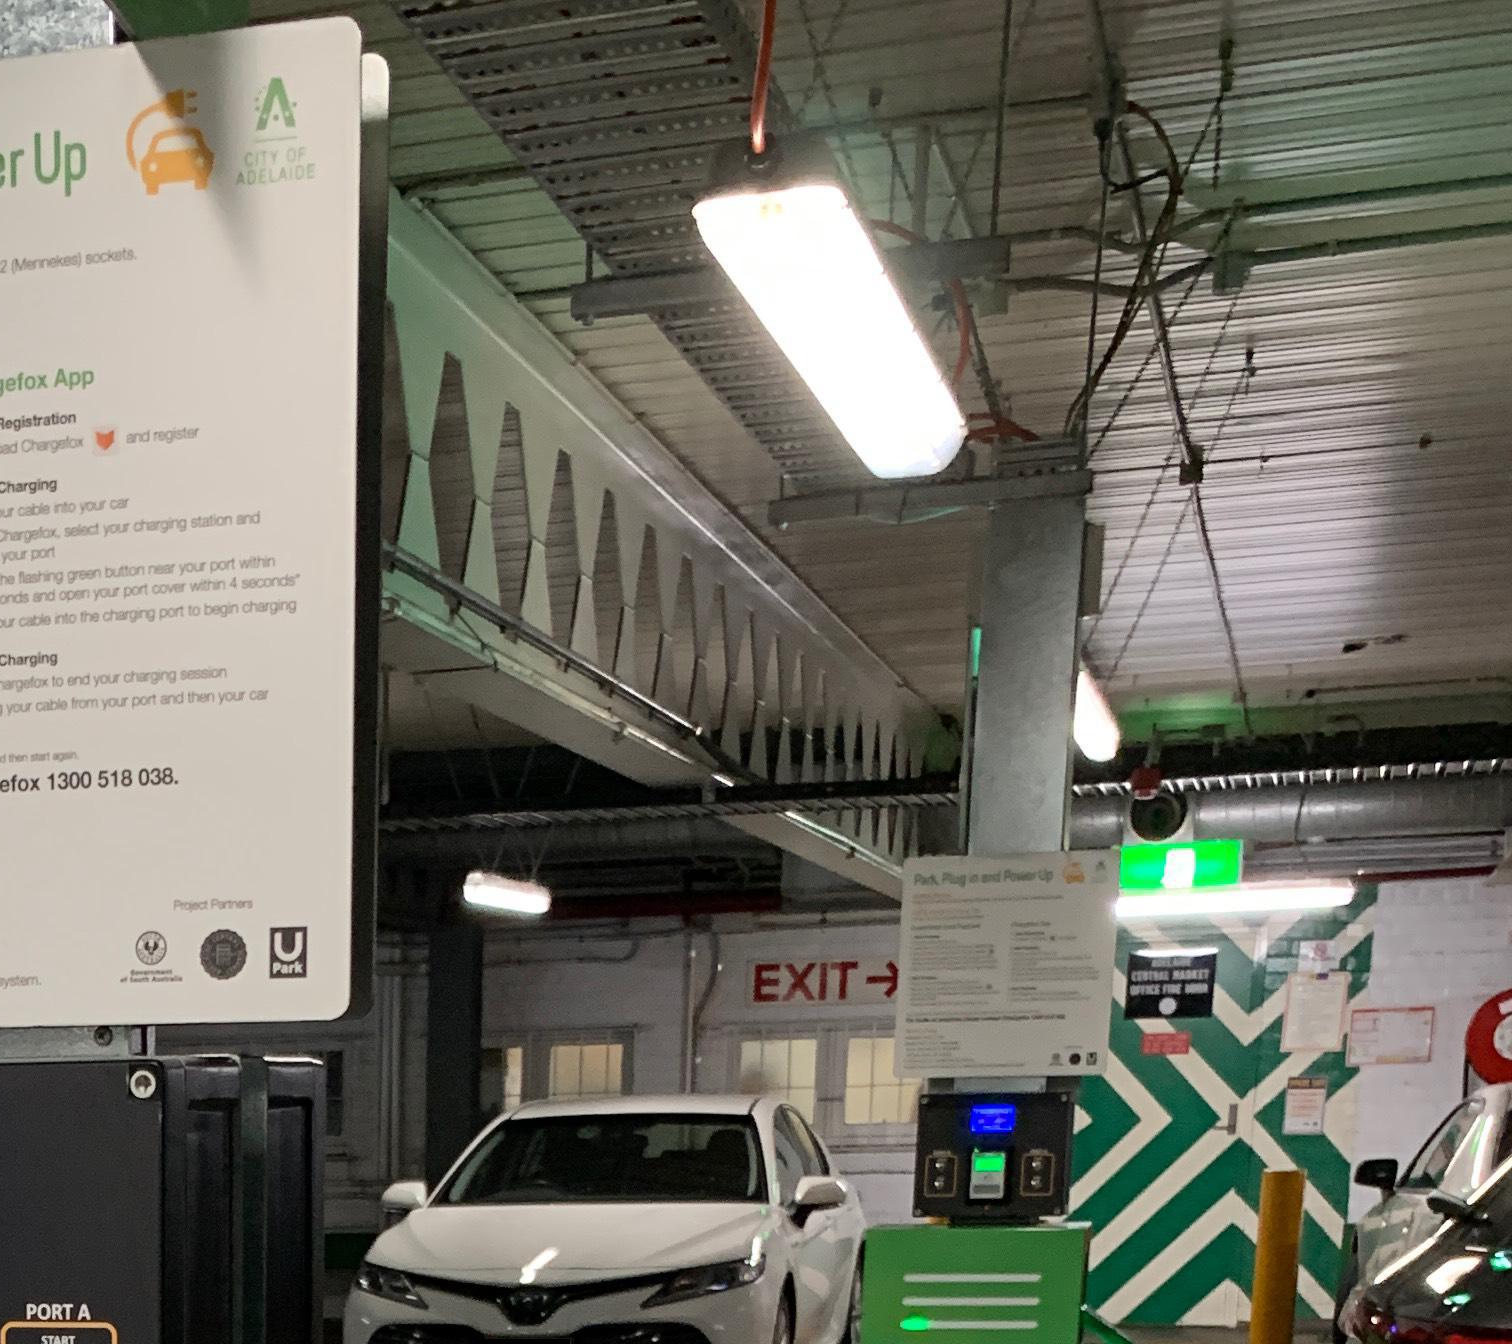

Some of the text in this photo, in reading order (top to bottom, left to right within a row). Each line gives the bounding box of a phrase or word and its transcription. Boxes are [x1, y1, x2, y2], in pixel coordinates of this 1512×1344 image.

[33, 132, 87, 198] Up
[244, 148, 306, 168] CITY OF
[235, 162, 315, 186] ADELAIDE
[0, 260, 8, 274] 2
[10, 252, 82, 275] (Mennekes)
[84, 247, 137, 265] sockets.
[53, 367, 95, 391] App
[46, 770, 92, 791] 1300
[97, 768, 133, 789] 518
[138, 766, 179, 787] 038.
[172, 898, 254, 913] Project Partners
[273, 932, 304, 962] U
[272, 961, 303, 976] Park
[753, 961, 858, 1003] EXIT
[26, 1304, 91, 1321] PORT A
